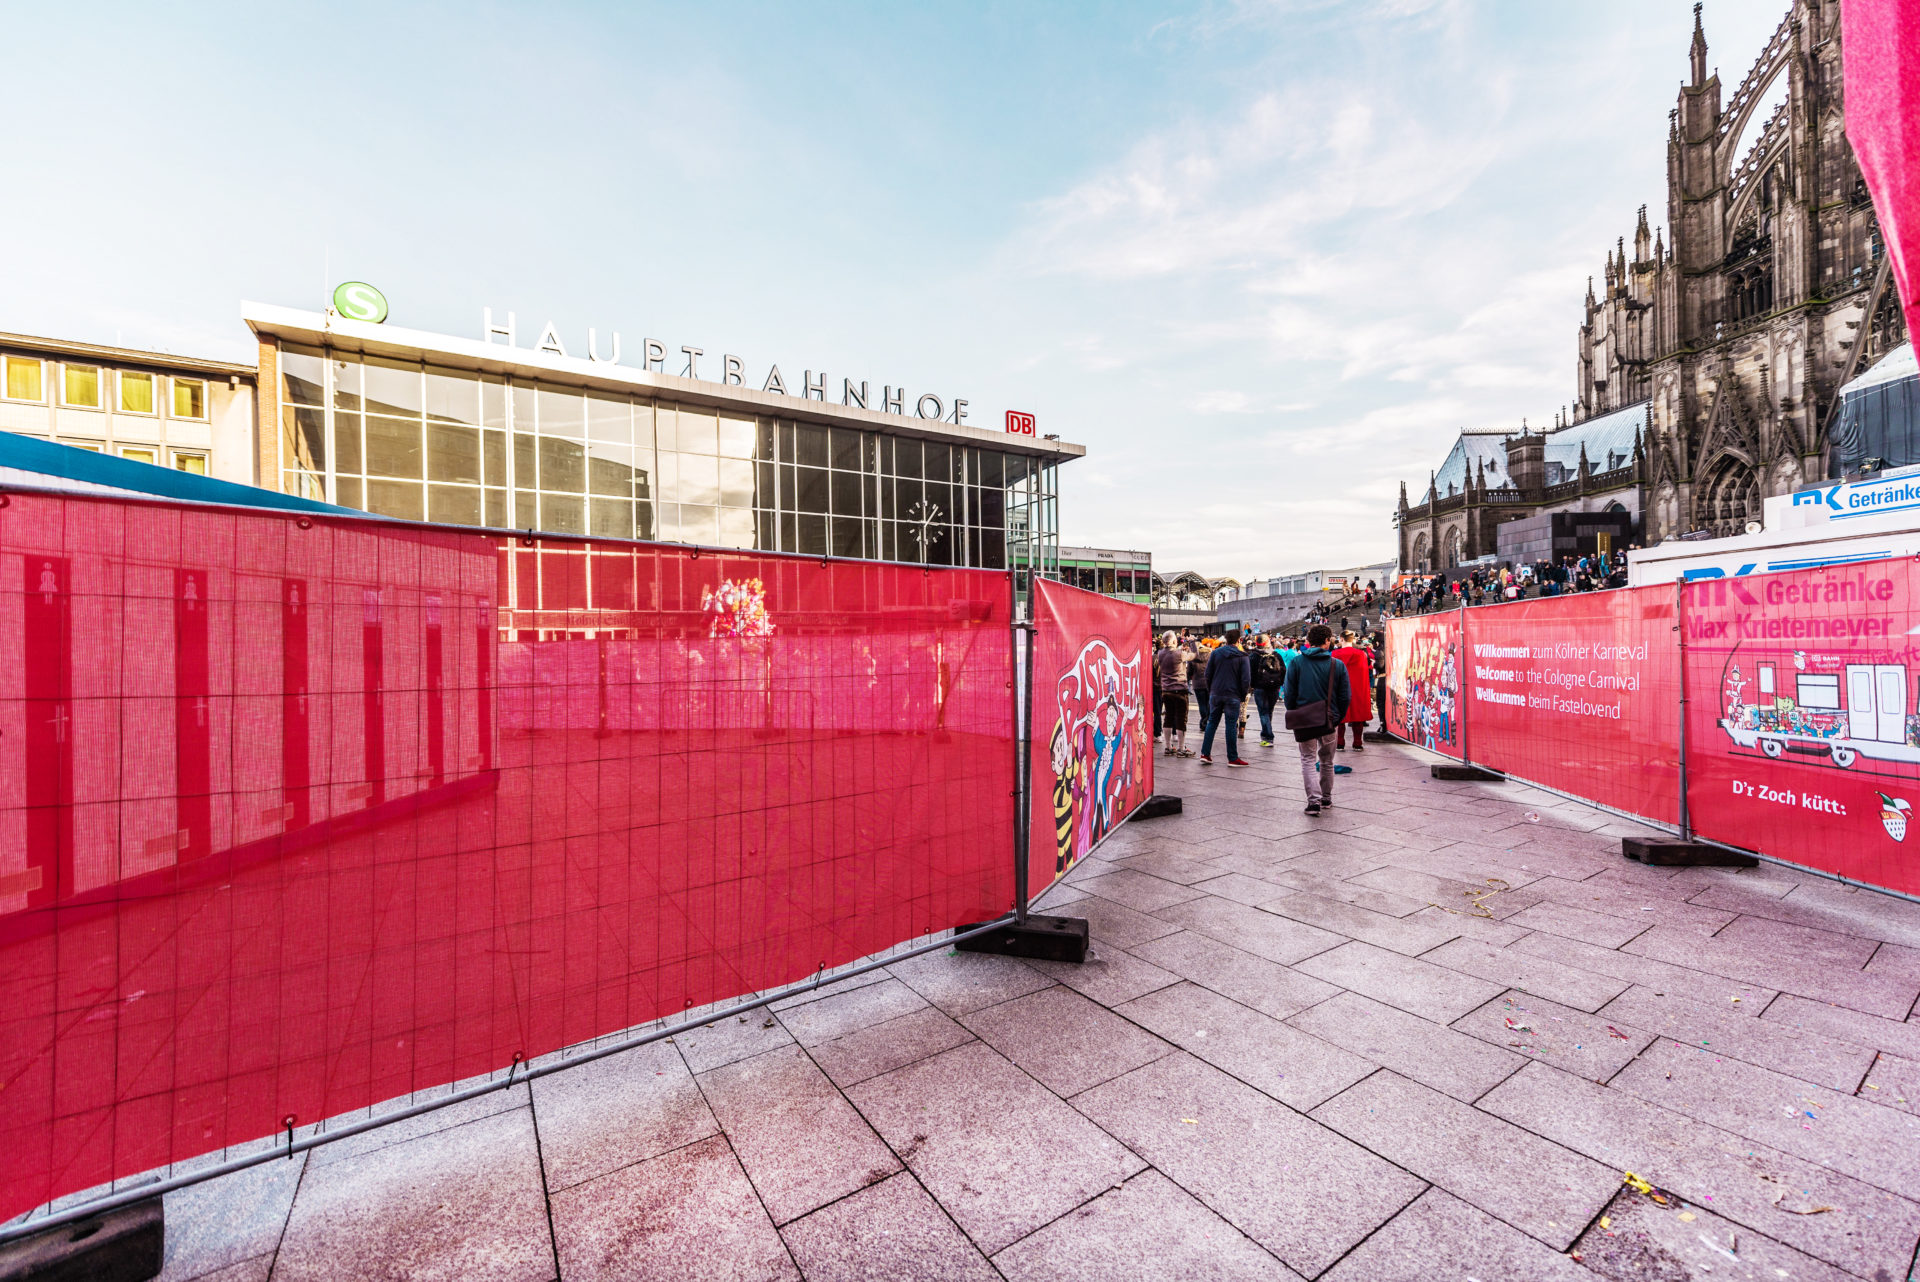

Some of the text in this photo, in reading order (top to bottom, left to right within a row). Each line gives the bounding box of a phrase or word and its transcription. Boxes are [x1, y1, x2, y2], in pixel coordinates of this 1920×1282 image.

[345, 286, 379, 320] S
[483, 307, 969, 425] HAUPTBAHNHOF
[1009, 413, 1033, 435] DB
[1766, 572, 1894, 606] Getränke
[1688, 612, 1894, 647] Max Krietemeyer
[1474, 641, 1648, 661] Willkommen zum Kölner Karneval
[1475, 666, 1640, 691] Welcome to the Cologne Carnival
[1528, 692, 1550, 710] beim
[1553, 695, 1621, 720] Fastelovend
[1758, 785, 1796, 806] Zoch
[1802, 792, 1847, 816] kütt:
